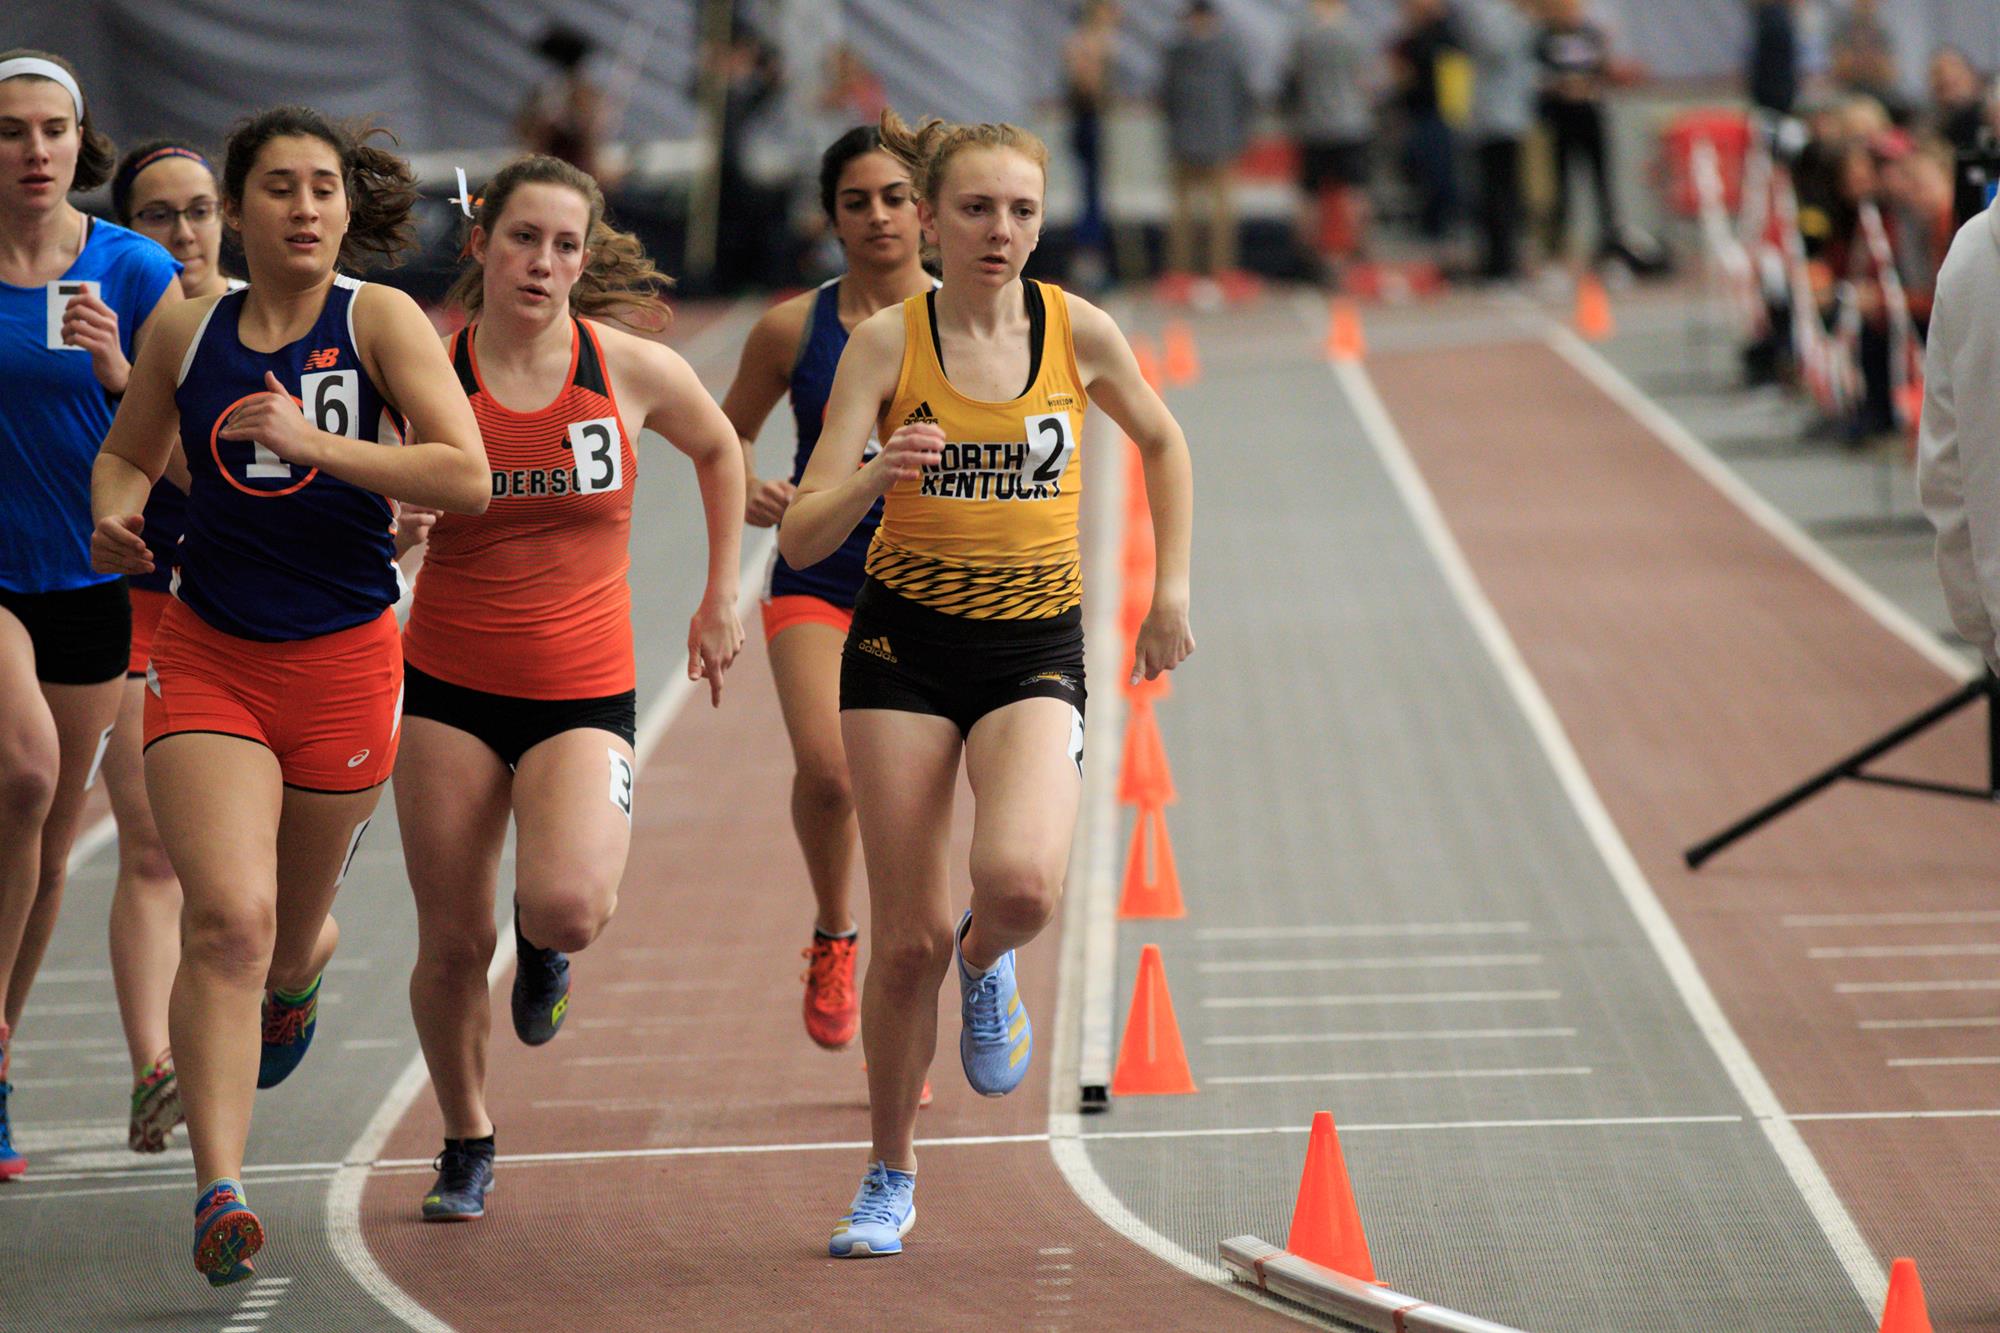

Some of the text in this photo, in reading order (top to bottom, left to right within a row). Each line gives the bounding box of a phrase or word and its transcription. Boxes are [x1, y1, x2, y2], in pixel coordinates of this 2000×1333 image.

[315, 374, 349, 438] 6
[582, 424, 614, 489] 3
[921, 442, 1030, 473] ORTH
[1032, 417, 1065, 482] 2
[858, 642, 898, 664] adidas
[618, 758, 631, 815] 3
